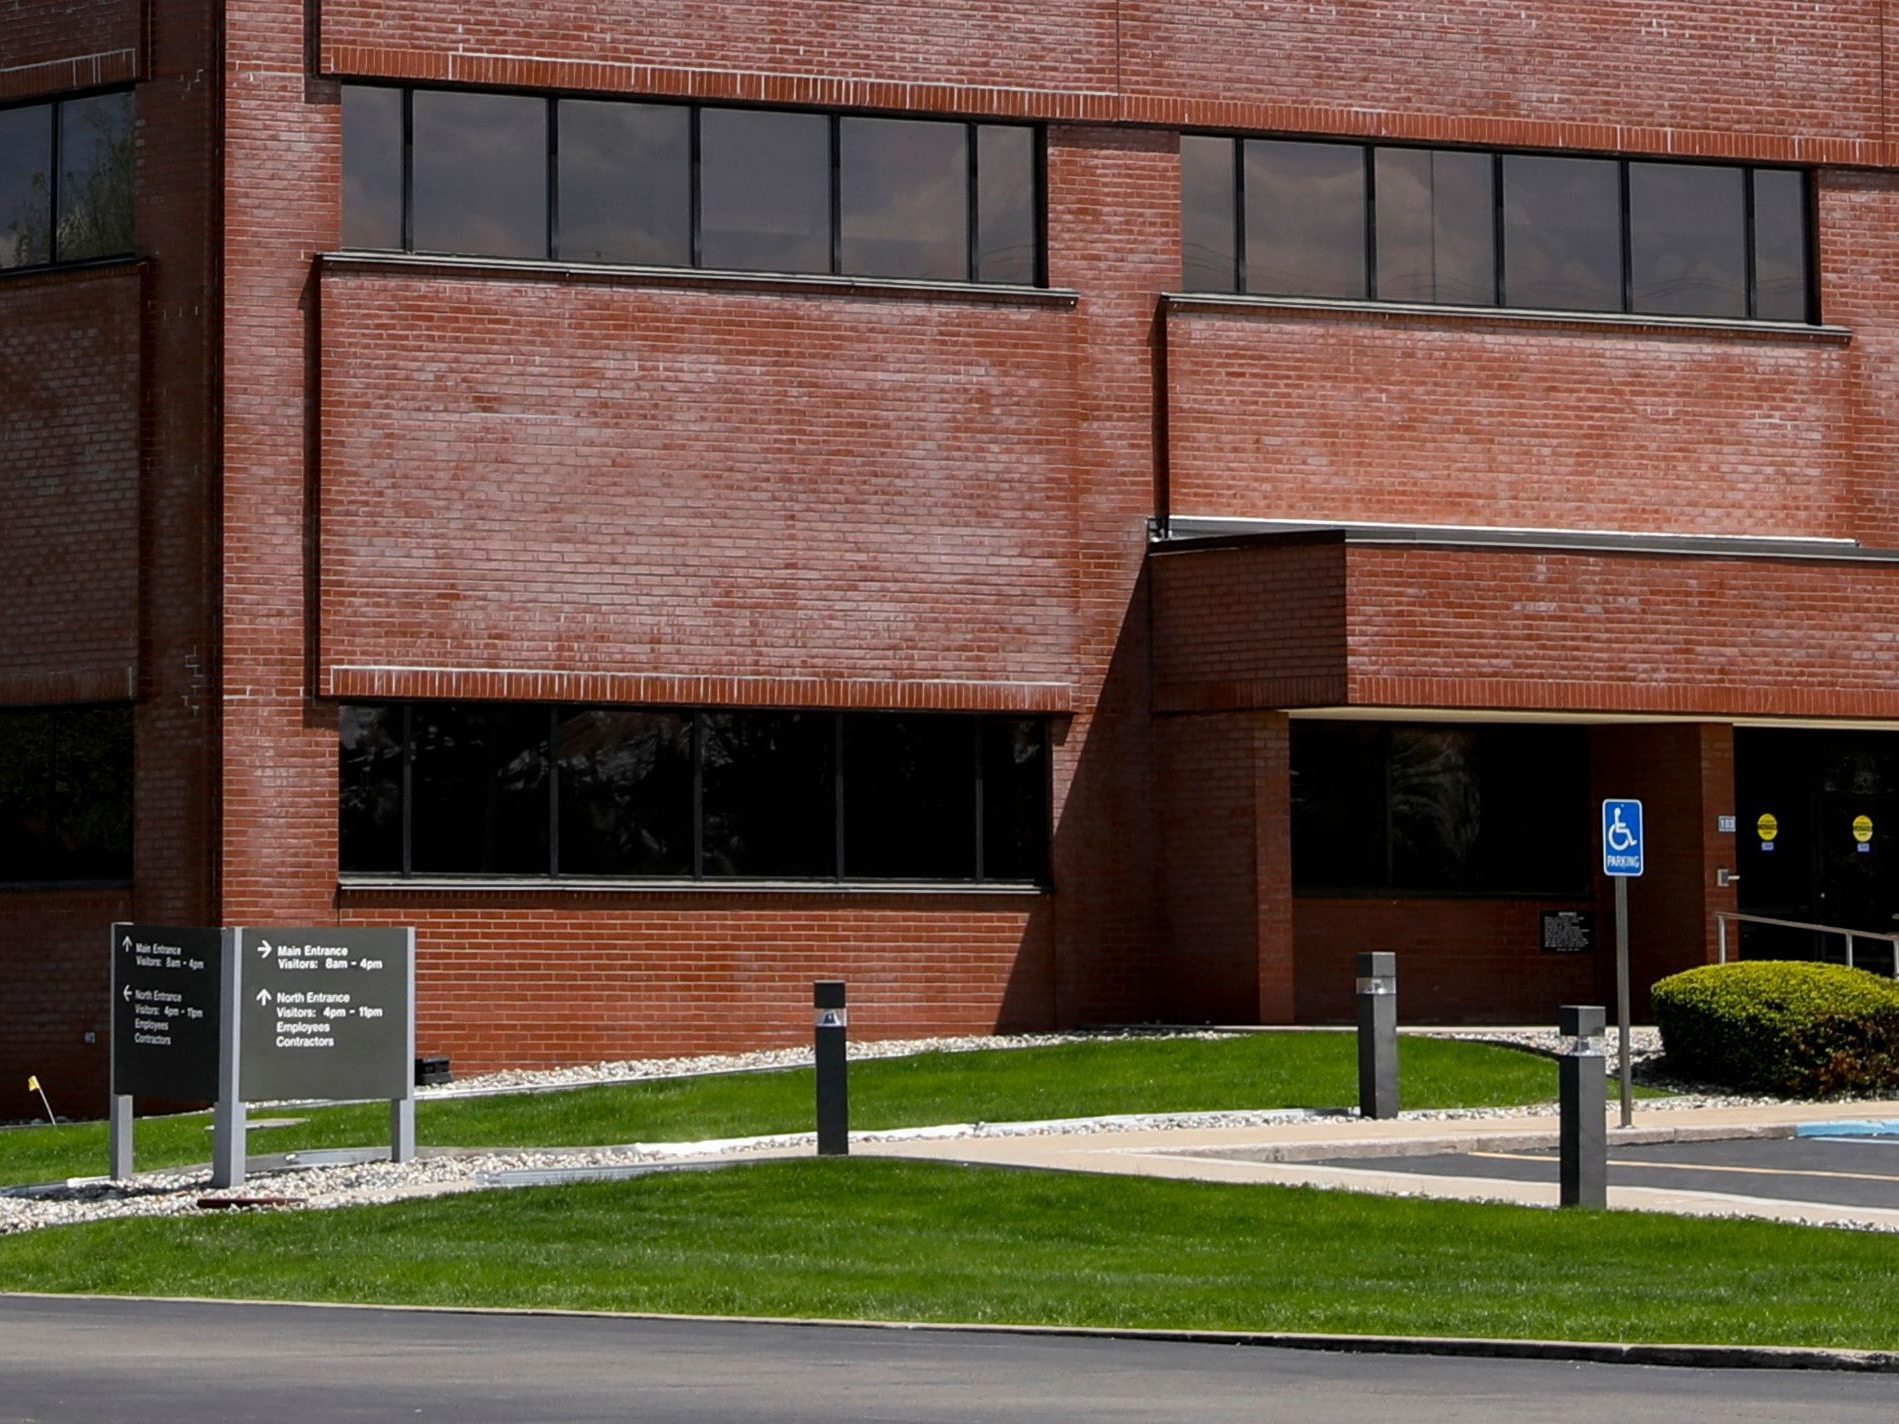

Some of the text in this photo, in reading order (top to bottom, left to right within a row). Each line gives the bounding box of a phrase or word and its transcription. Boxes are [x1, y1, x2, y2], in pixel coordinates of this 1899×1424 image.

[1607, 855, 1640, 868] PARKING
[135, 943, 182, 956] Main Entrance
[277, 945, 348, 956] Main Entrance
[189, 958, 204, 970] 4pm
[278, 958, 318, 969] Visitors:
[325, 958, 348, 969] 8am
[360, 958, 383, 971] 4pm
[135, 990, 182, 1002] North Entrance
[277, 992, 350, 1003] North Entrance
[277, 1006, 316, 1018] Visitors:
[323, 1006, 346, 1019] 4pm
[359, 1006, 383, 1019] 11pm
[135, 1018, 169, 1031] Employees
[276, 1021, 330, 1034] Employees
[134, 1032, 171, 1045] Contractors
[276, 1036, 334, 1047] Contractors
